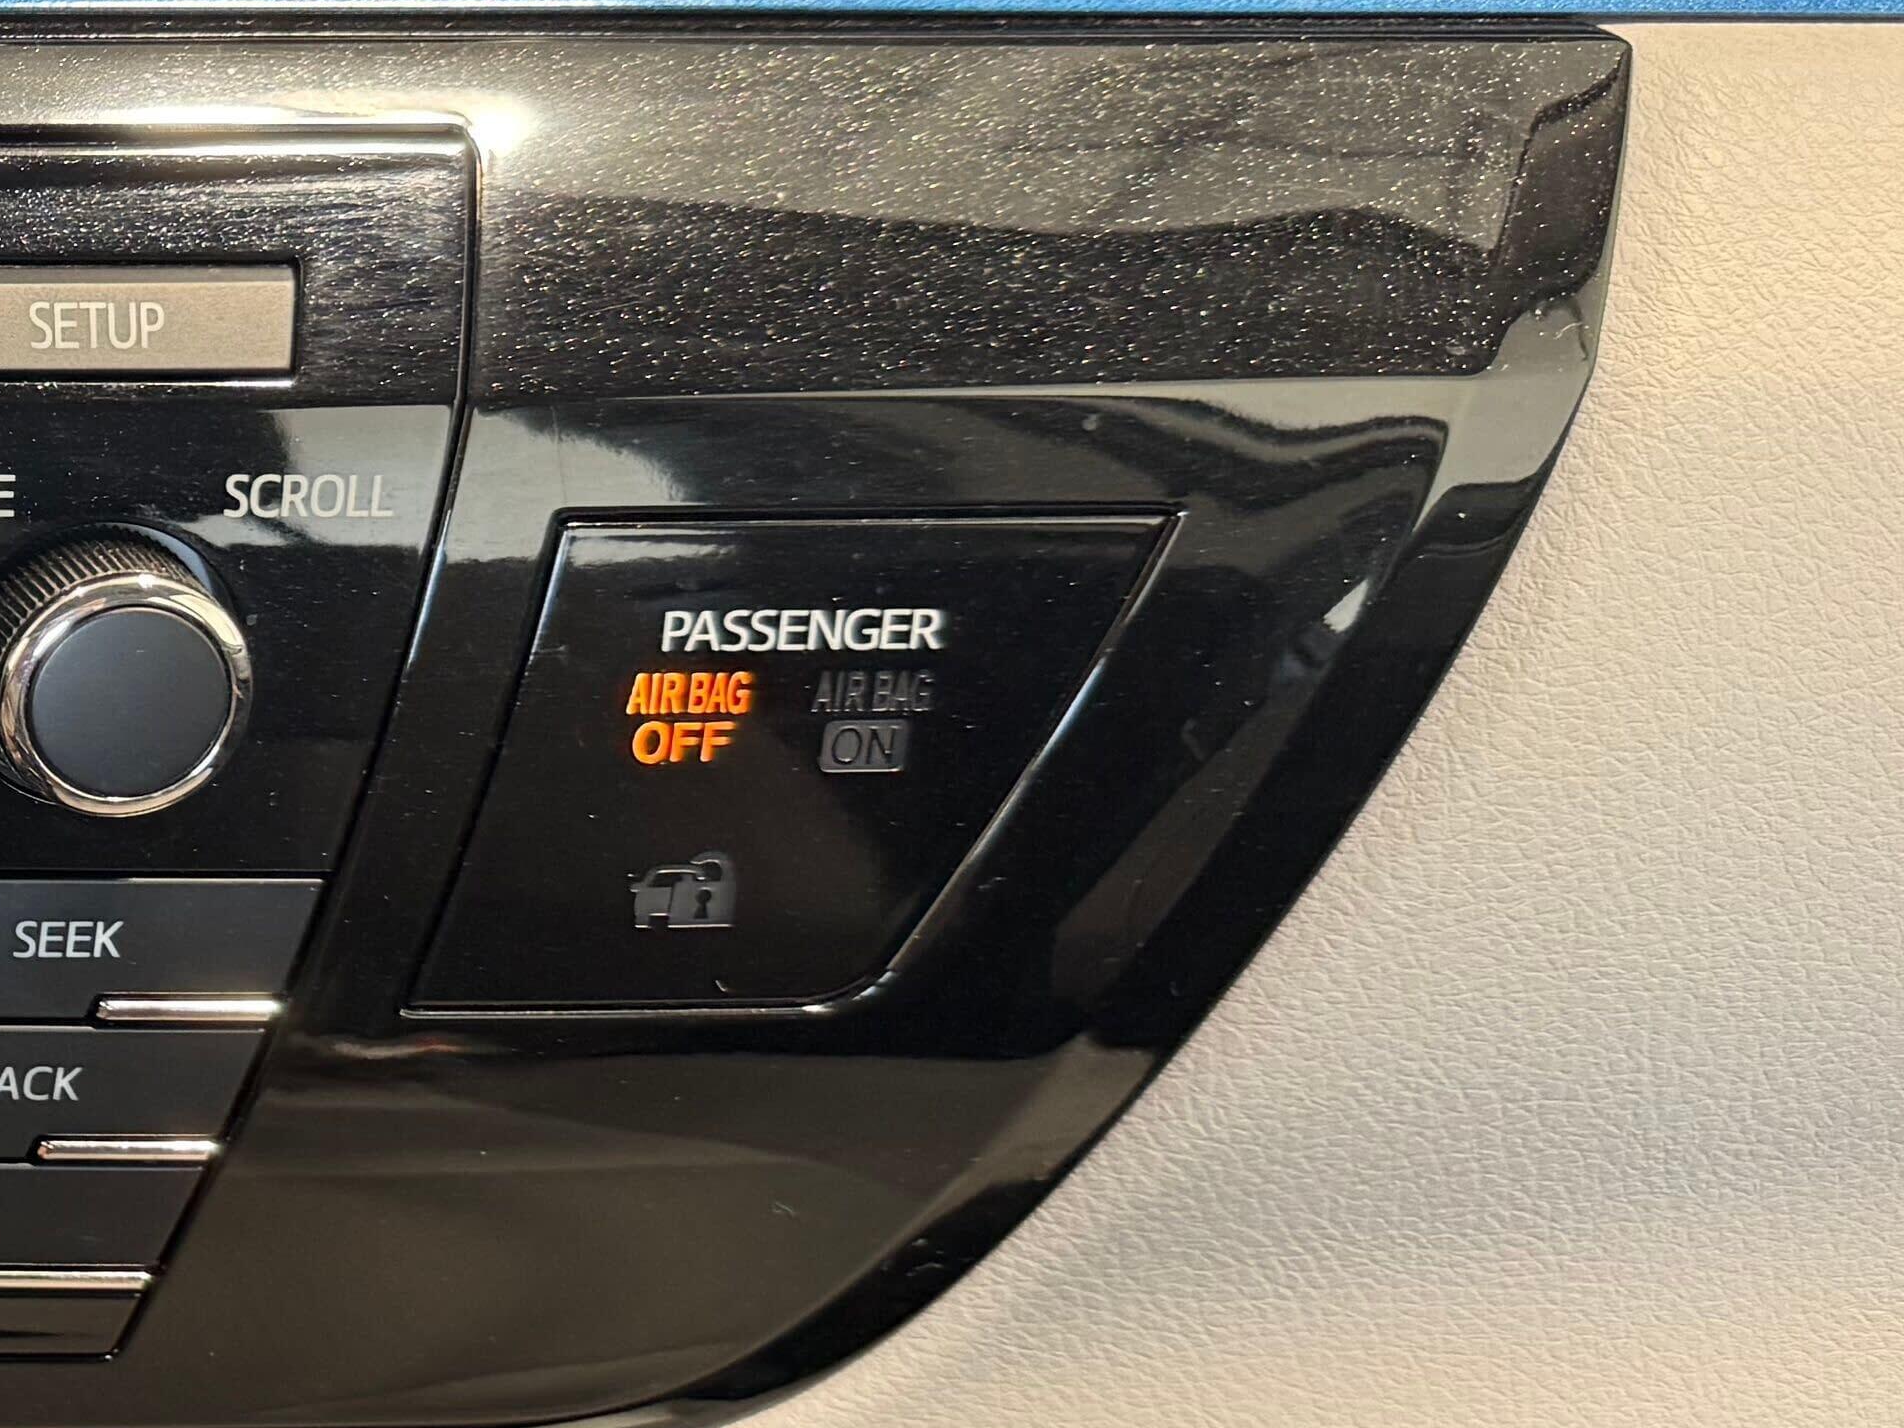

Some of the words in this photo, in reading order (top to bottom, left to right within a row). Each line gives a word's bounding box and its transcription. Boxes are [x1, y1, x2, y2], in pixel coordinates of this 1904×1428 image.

[28, 300, 166, 351] SETUP
[222, 474, 394, 519] SCROLL
[660, 607, 948, 653] PASSENGER
[625, 671, 684, 717] AIR
[686, 671, 752, 715] BAG
[810, 671, 865, 714] AIR
[870, 670, 934, 713] BAG
[630, 720, 738, 765] OFF
[830, 725, 900, 765] ON
[11, 920, 125, 960] SEEK
